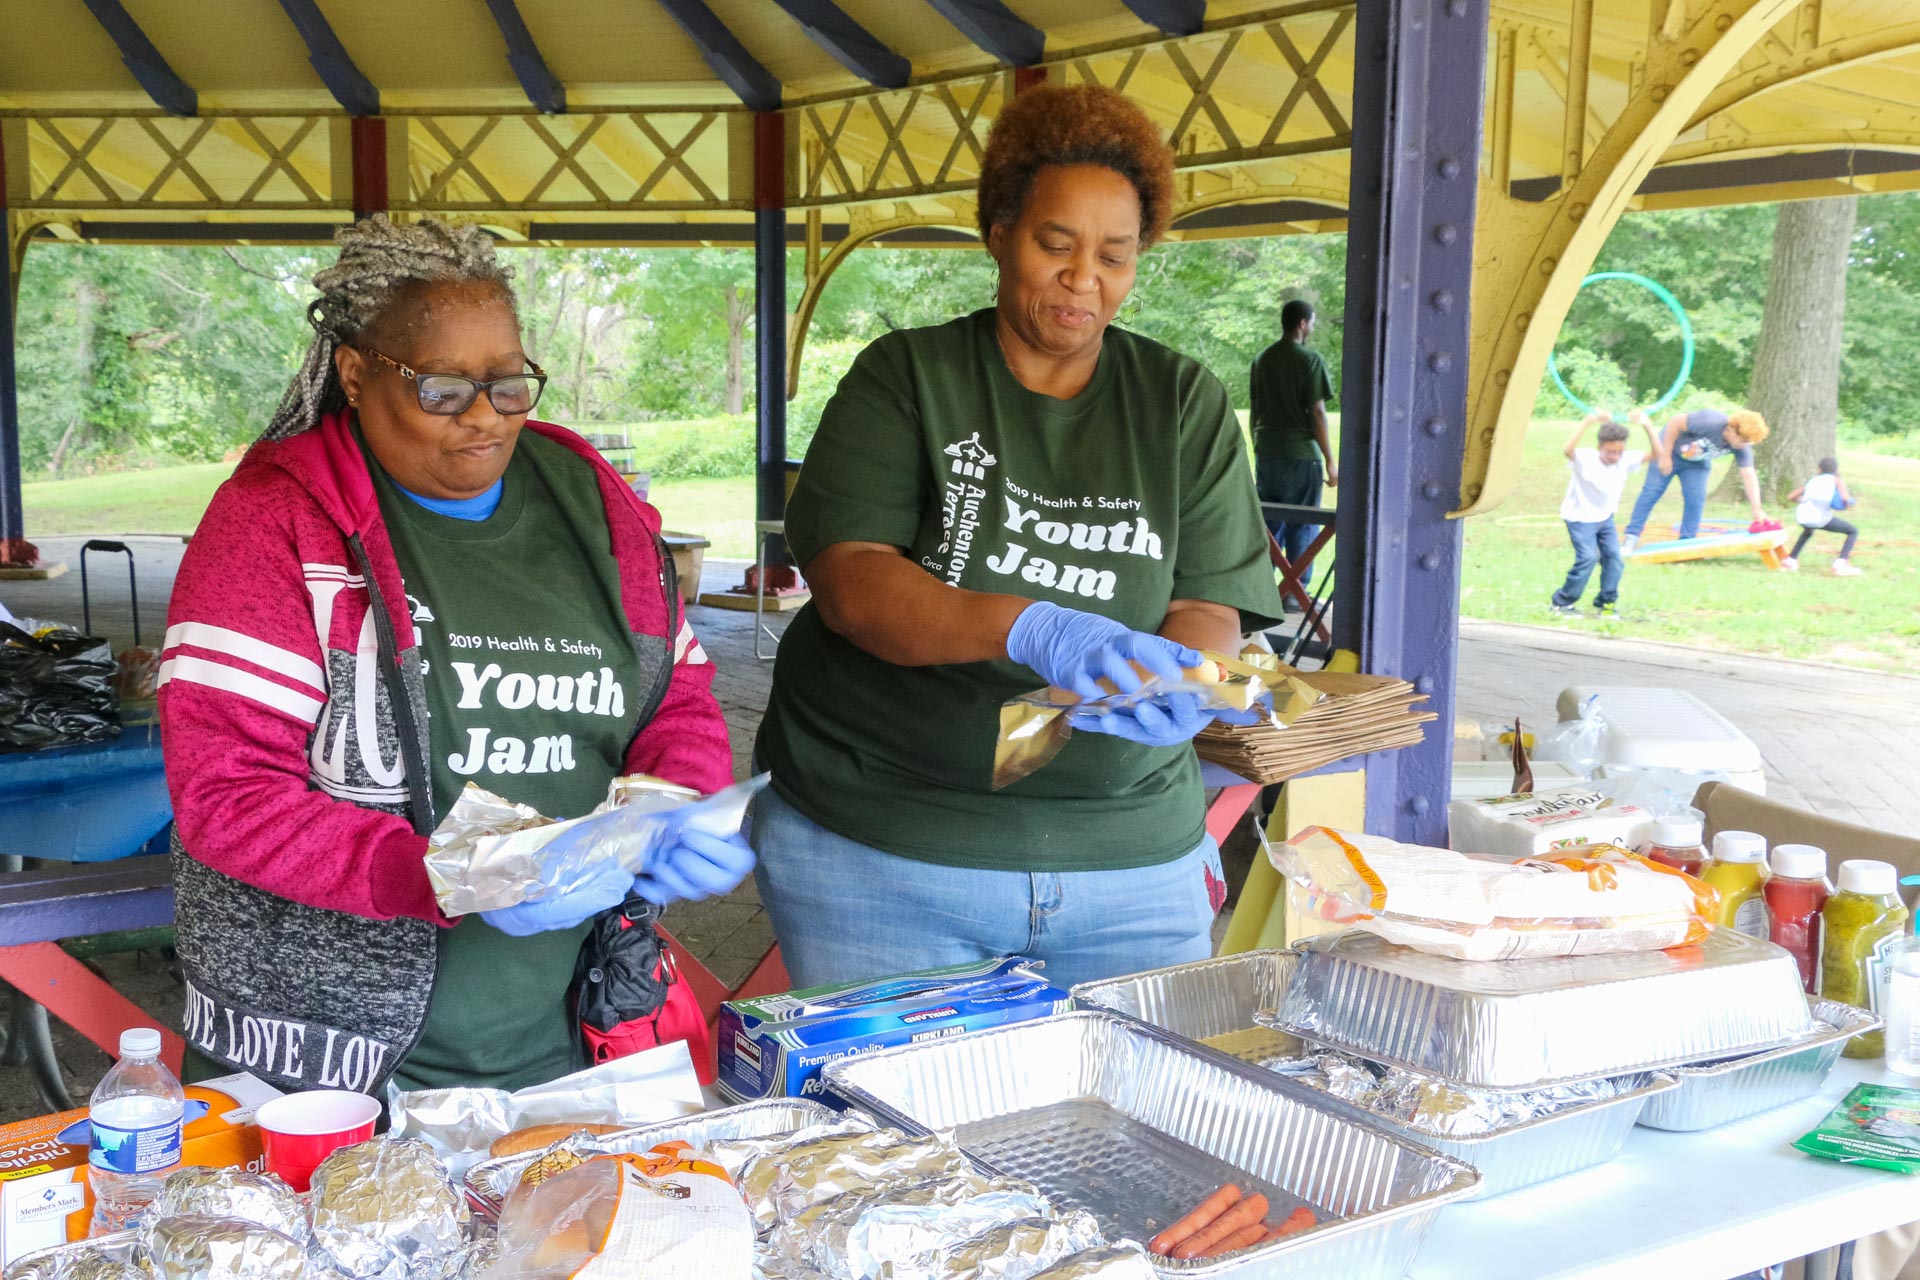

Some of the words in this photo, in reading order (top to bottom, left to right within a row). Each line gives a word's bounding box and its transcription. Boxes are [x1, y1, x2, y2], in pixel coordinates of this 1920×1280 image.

[1005, 477, 1029, 498] 2019
[1033, 493, 1077, 508] Health
[1082, 496, 1093, 508] &
[1098, 496, 1141, 510] Safety
[938, 481, 966, 553] Terrace
[1004, 495, 1163, 560] Youth
[921, 555, 943, 571] Circa
[986, 542, 1117, 600] Jam
[449, 633, 482, 649] 2019
[487, 636, 539, 652] Health
[544, 638, 556, 652] &
[561, 639, 602, 660] Safety
[450, 662, 625, 717] Youth
[448, 727, 576, 775] Jam
[183, 978, 216, 1052] OVE
[225, 1008, 306, 1079] LOVE
[903, 1008, 958, 1023] KIRKLAND
[799, 1050, 844, 1068] Premium
[0, 1147, 71, 1169] nitrile
[20, 1202, 56, 1217] Member's
